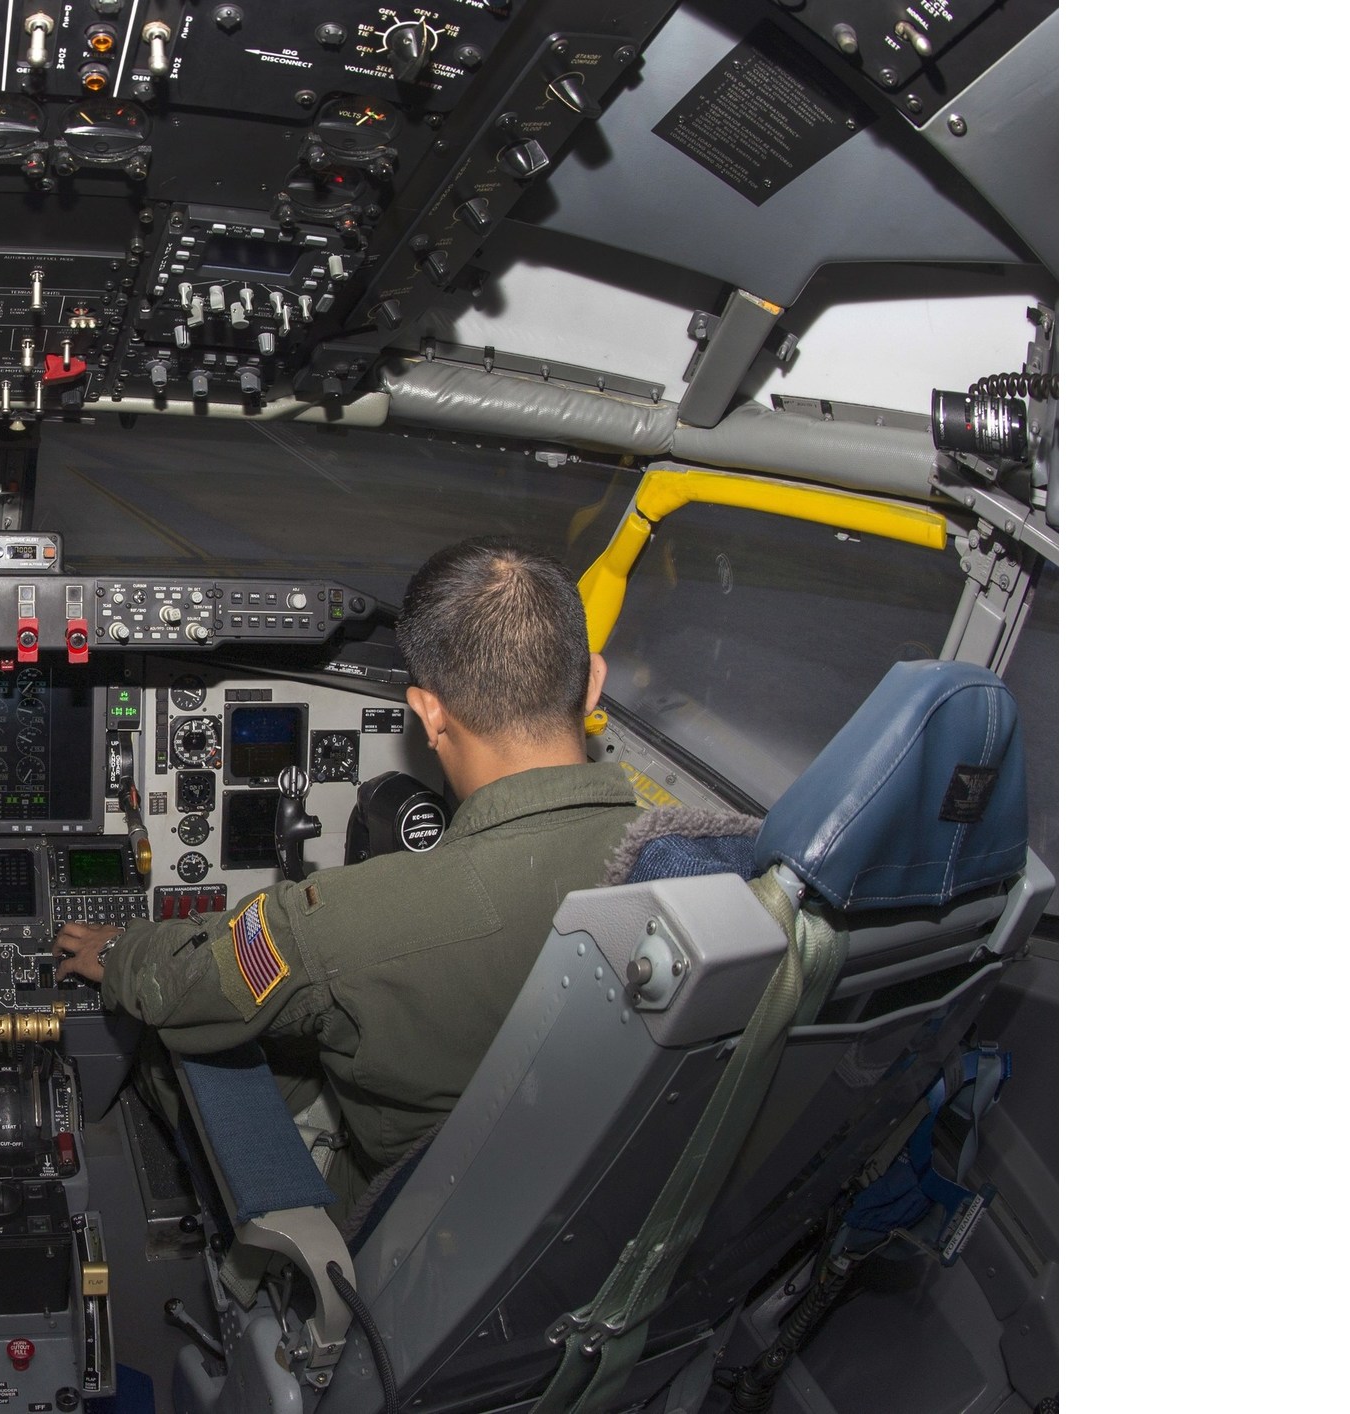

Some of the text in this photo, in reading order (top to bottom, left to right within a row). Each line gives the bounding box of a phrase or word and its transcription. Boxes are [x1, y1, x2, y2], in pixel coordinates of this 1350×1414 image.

[62, 5, 72, 28] DISC
[378, 8, 397, 17] GEN
[413, 8, 432, 17] GEN
[906, 7, 929, 31] NORMAL
[180, 16, 193, 39] DISC
[358, 23, 374, 32] BUS
[356, 45, 373, 53] GEN
[884, 35, 901, 51] TEST
[56, 48, 66, 70] NORM
[282, 48, 298, 56] IDG
[169, 57, 182, 79] NORM
[261, 55, 313, 69] DISCONNECT
[344, 65, 387, 78] VOLTMETER
[338, 109, 361, 119] VOLTS
[754, 94, 789, 122] GENERATORS
[408, 828, 438, 839] BOEING
[944, 1237, 958, 1256] FOR
[956, 1196, 981, 1236] TRAINING
